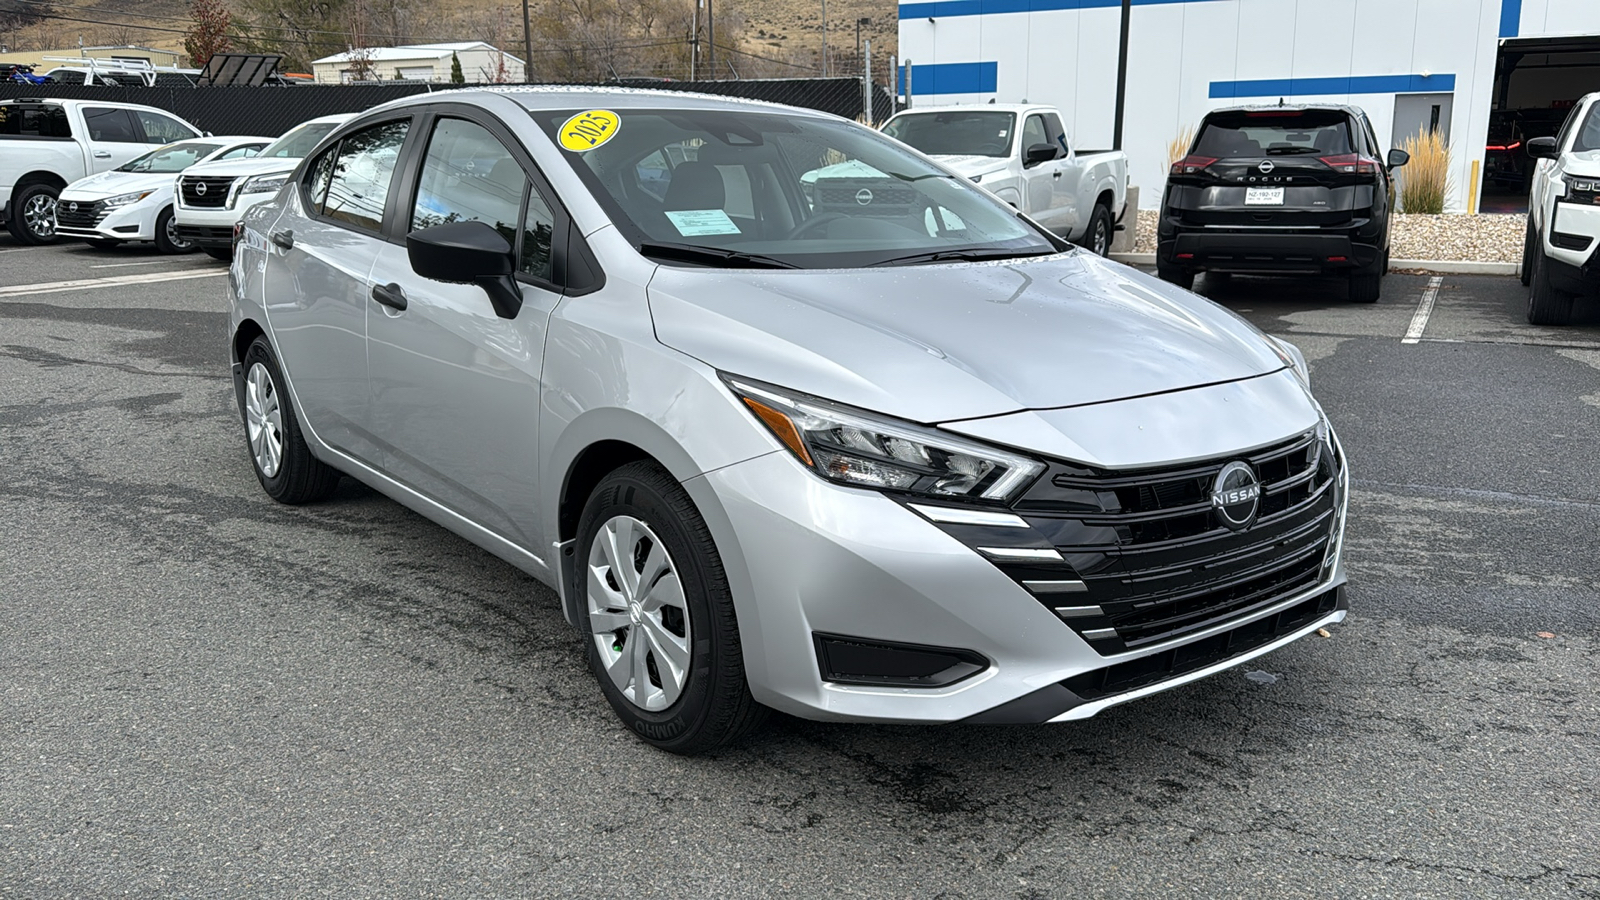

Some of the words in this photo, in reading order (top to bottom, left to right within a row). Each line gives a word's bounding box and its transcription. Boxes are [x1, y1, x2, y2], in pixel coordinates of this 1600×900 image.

[569, 113, 611, 145] 2025
[1212, 486, 1260, 506] NISSAN
[635, 716, 686, 739] KUMHO
